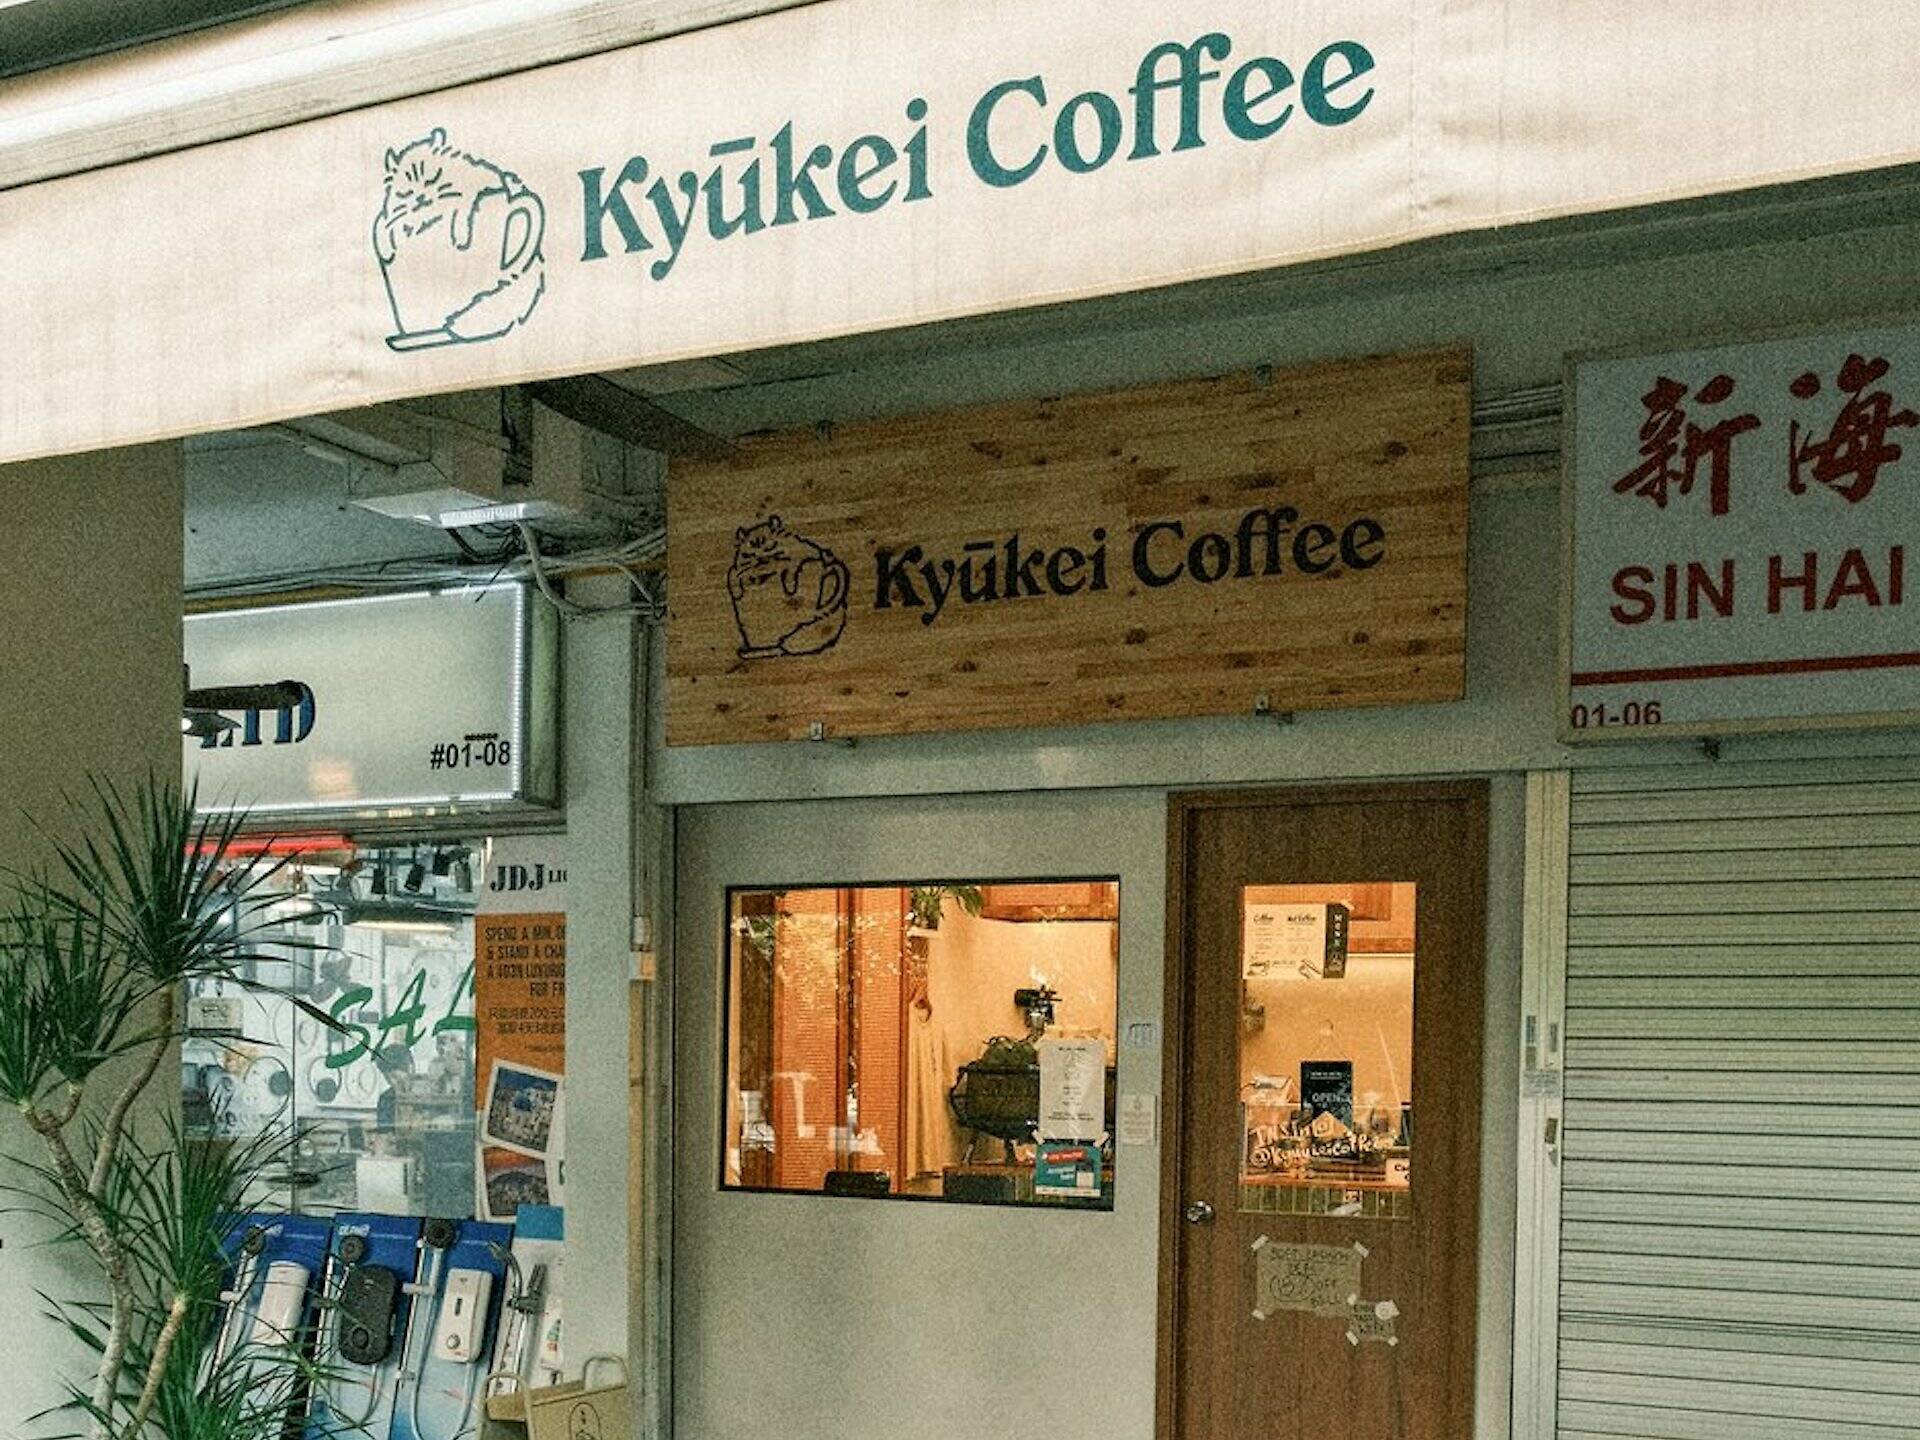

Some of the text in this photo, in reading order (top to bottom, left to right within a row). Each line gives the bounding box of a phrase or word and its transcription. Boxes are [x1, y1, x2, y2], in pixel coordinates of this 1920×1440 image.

[578, 32, 1376, 281] Kyūkei Coffee
[1612, 353, 1919, 516] 新海
[873, 507, 1386, 626] Kyūkei Coffee
[1609, 545, 1904, 626] SIN HAI
[430, 741, 511, 770] #01-08
[1571, 702, 1662, 729] 01-06
[489, 864, 545, 892] JDJ
